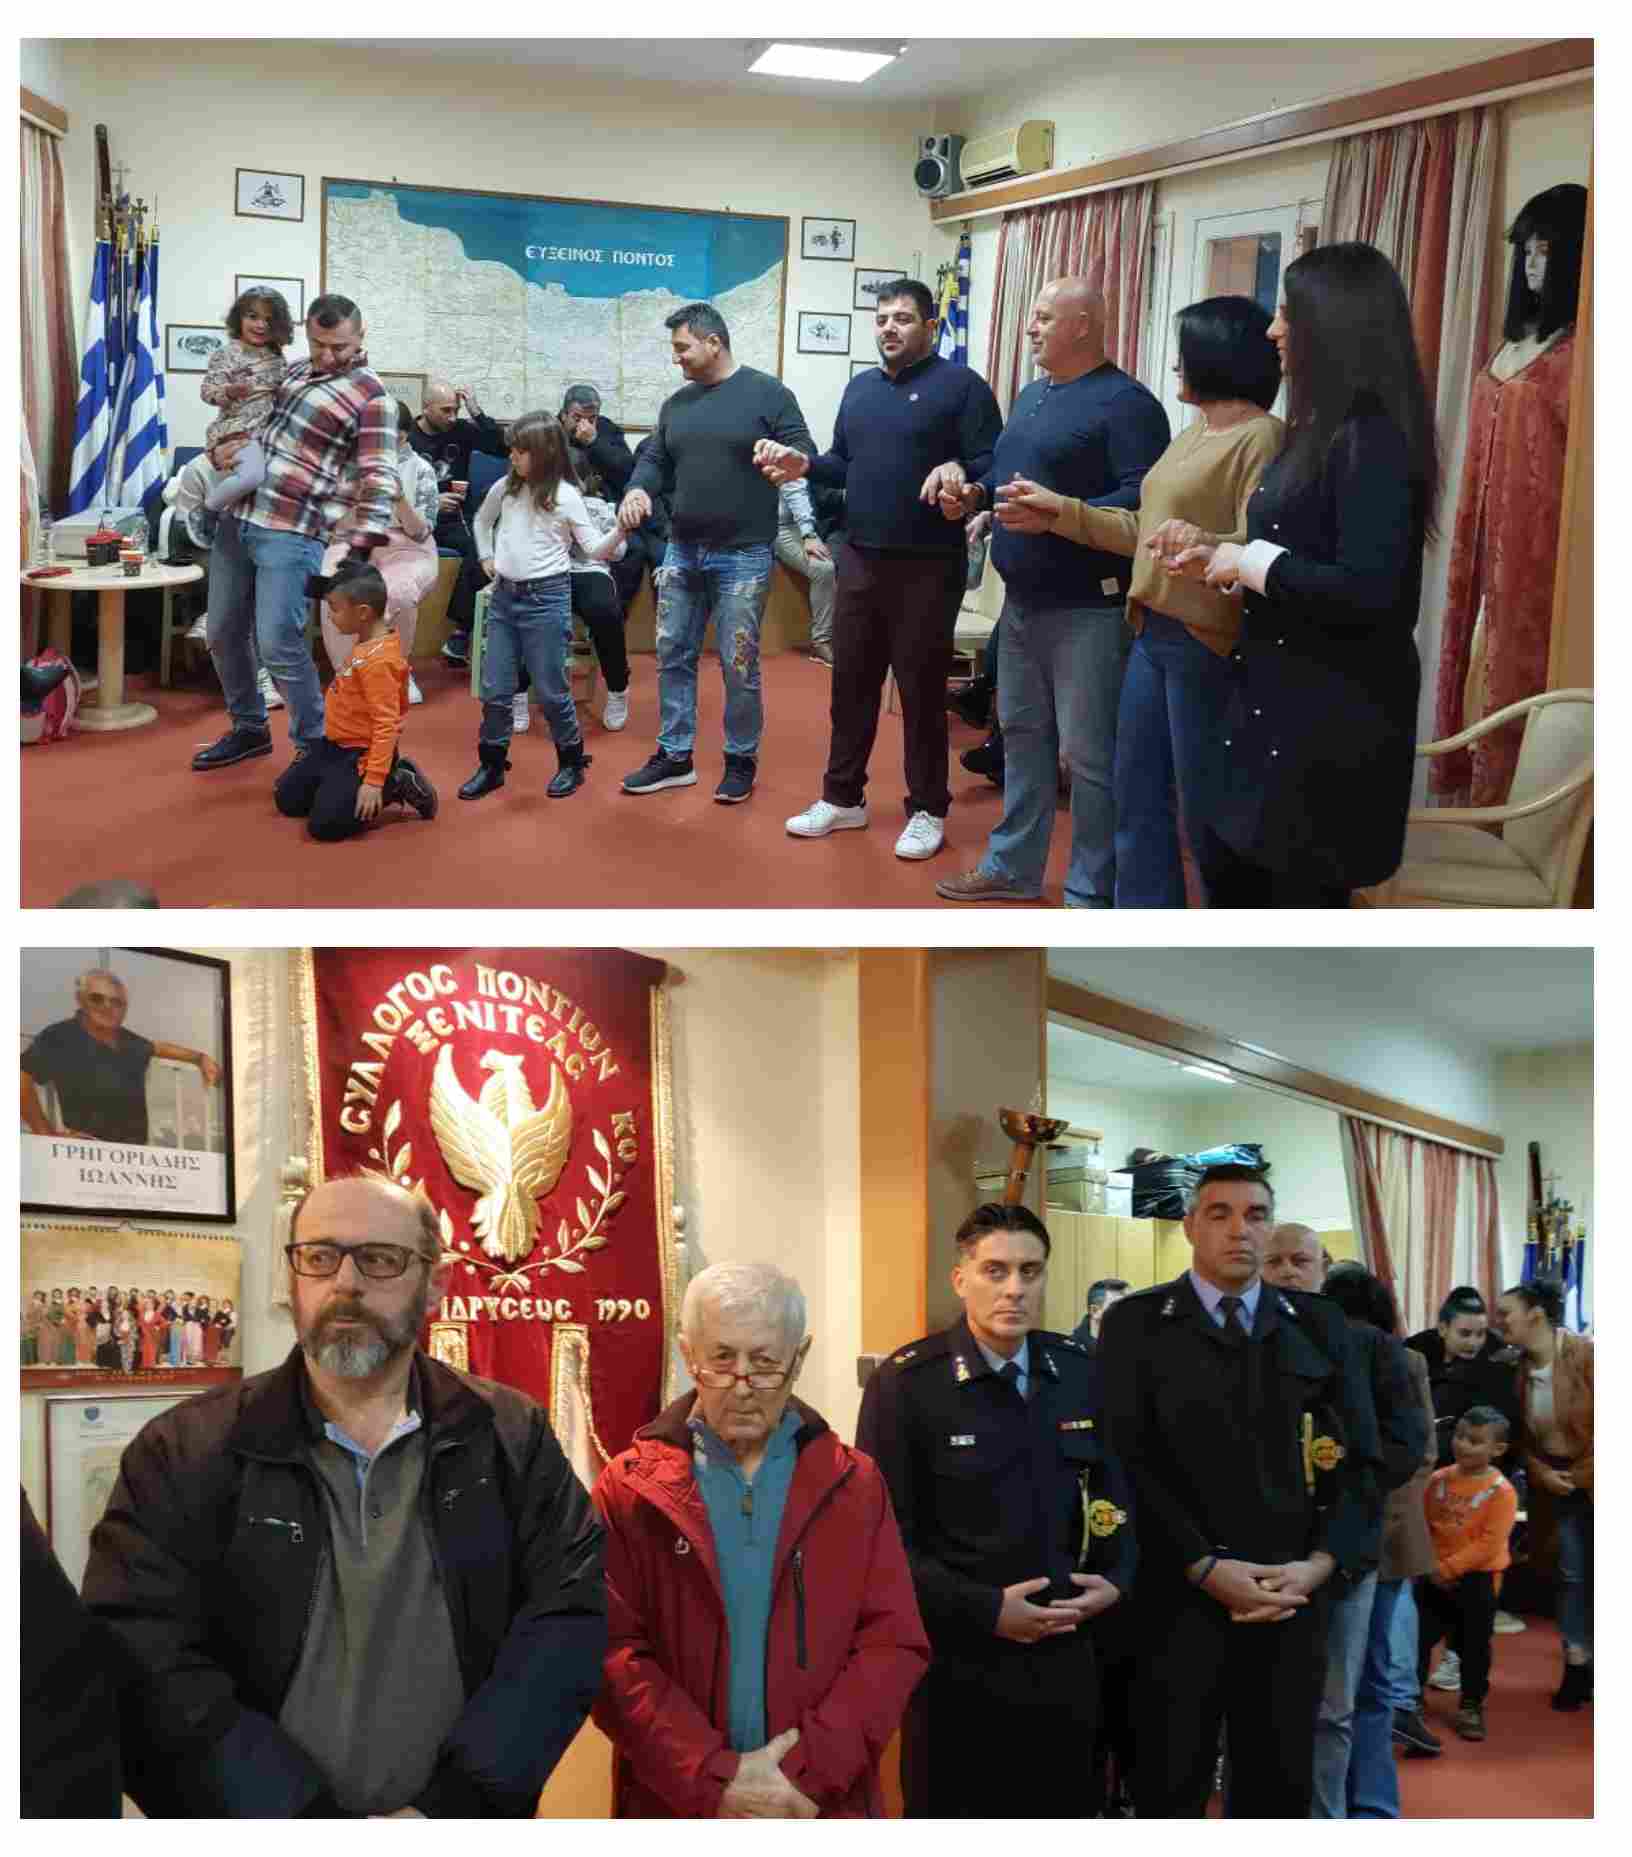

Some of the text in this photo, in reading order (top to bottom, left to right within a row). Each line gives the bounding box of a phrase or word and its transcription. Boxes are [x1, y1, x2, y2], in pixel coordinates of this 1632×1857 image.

[524, 245, 676, 267] ΕΥΞΕΙΝΟΣ ΠΟΝΤΟΣ
[50, 1142, 201, 1171] ΓΡΗΓΟΡΙΑΔΗΣ
[79, 1167, 177, 1190] ΙΩΑΝΝΗΣ
[592, 1297, 652, 1322] 1990
